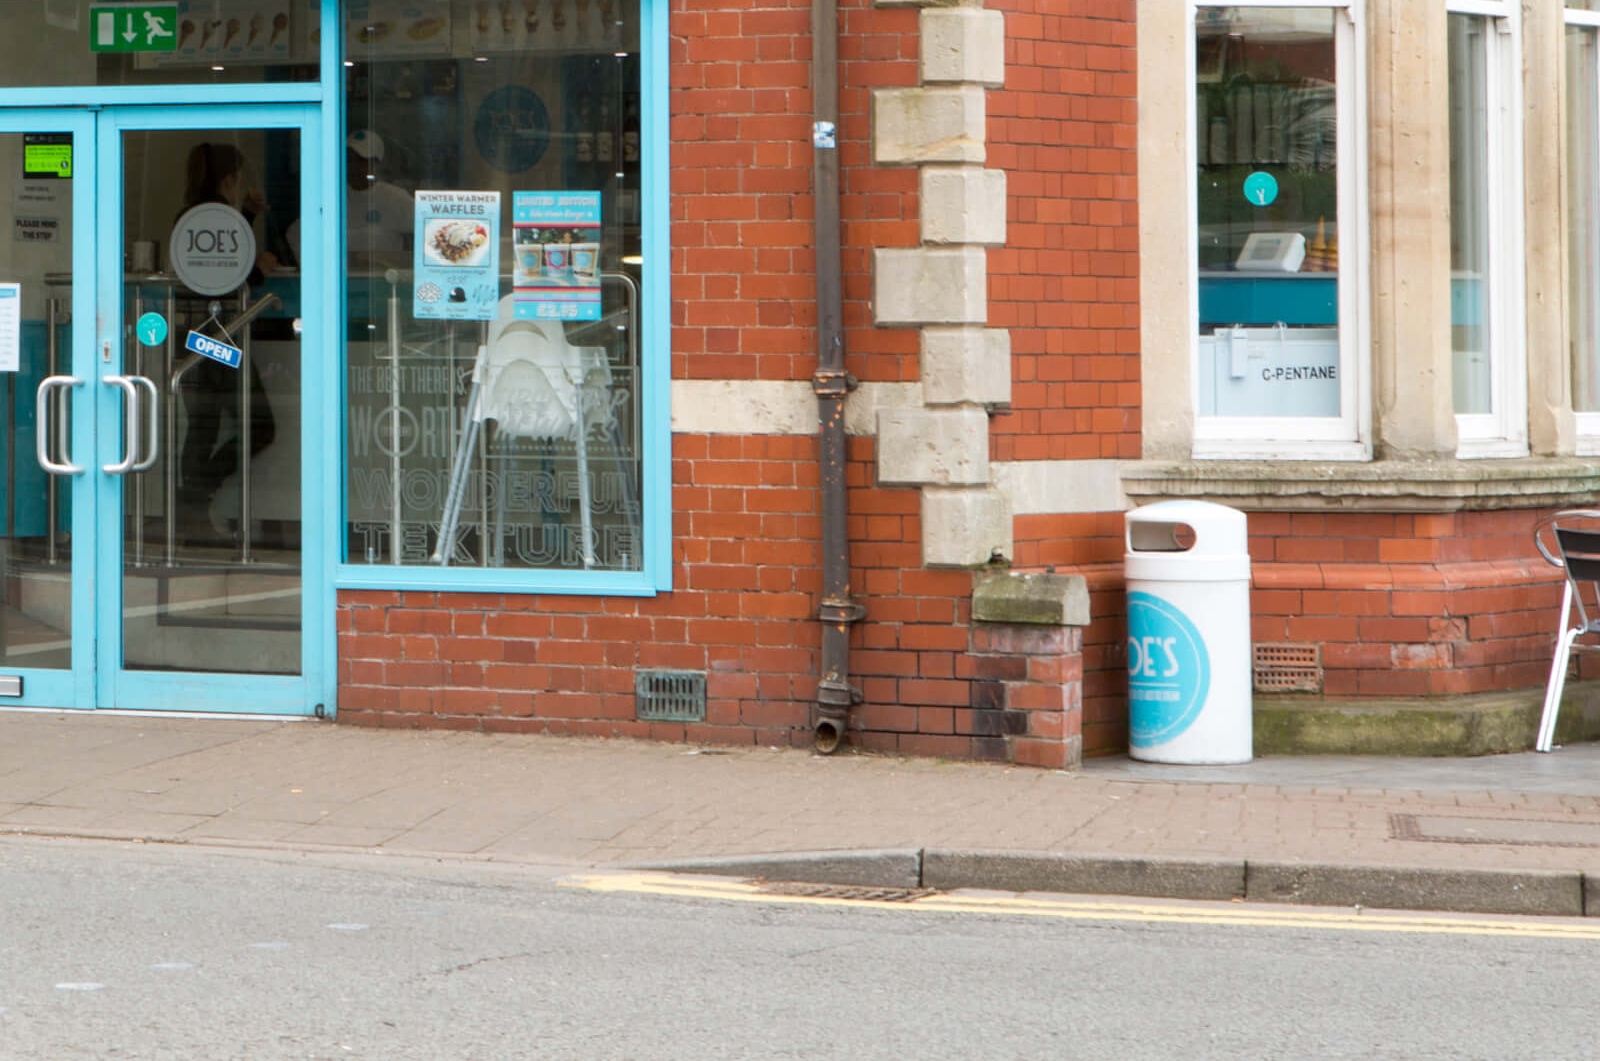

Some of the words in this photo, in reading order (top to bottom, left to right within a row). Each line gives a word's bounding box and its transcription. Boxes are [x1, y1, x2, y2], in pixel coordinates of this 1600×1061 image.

[419, 194, 454, 204] WINTER
[456, 194, 496, 204] WARMER
[430, 204, 485, 216] WAFFLES
[186, 229, 239, 253] JOE'S
[195, 339, 233, 362] OPEN
[351, 365, 375, 393] THE
[1262, 366, 1337, 381] C-PENTANE
[353, 466, 640, 516] WONDERFUL
[352, 521, 641, 568] TEXTURE
[1128, 635, 1180, 678] OE'S
